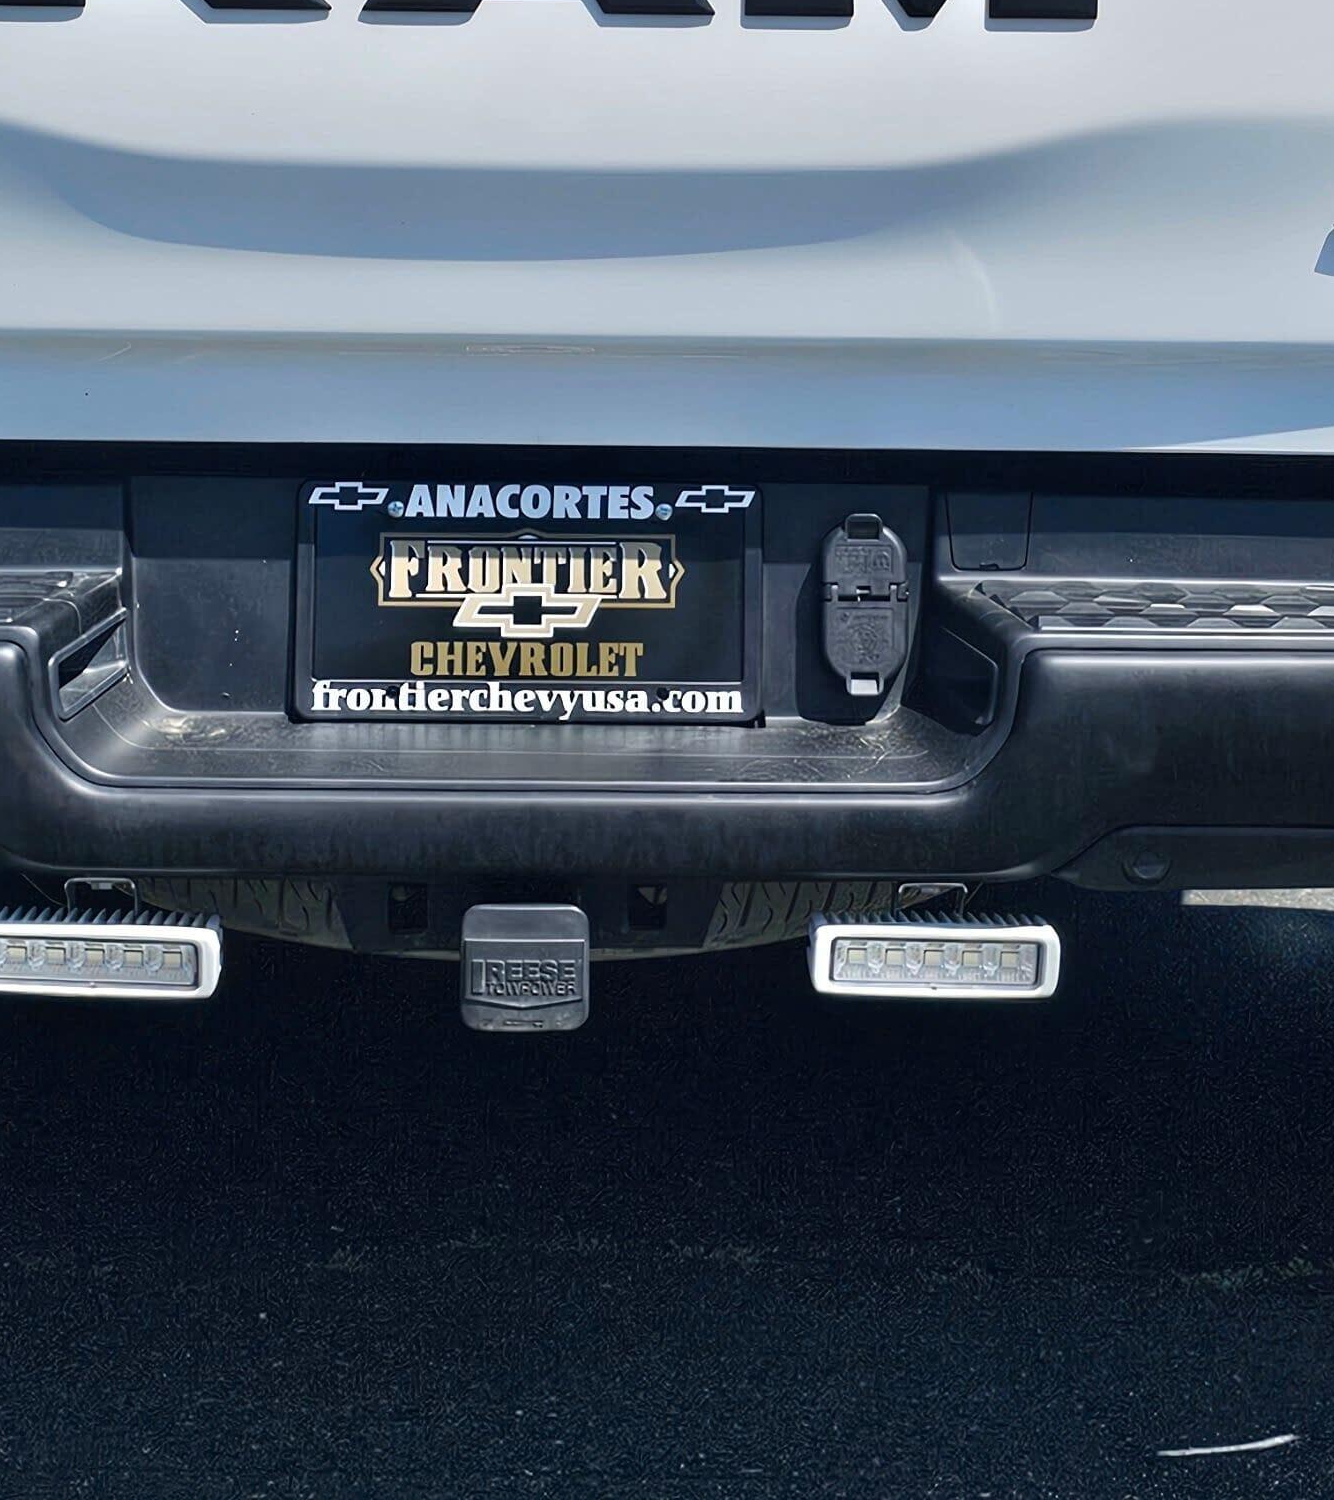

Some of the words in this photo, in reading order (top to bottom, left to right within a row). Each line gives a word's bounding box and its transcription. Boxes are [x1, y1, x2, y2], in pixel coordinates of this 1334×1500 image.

[403, 483, 655, 520] ANACORTES
[388, 538, 668, 600] FRONTIER
[409, 641, 644, 677] CHEVROLET
[310, 681, 743, 721] frontierchevyusa.com
[486, 959, 576, 981] REESE
